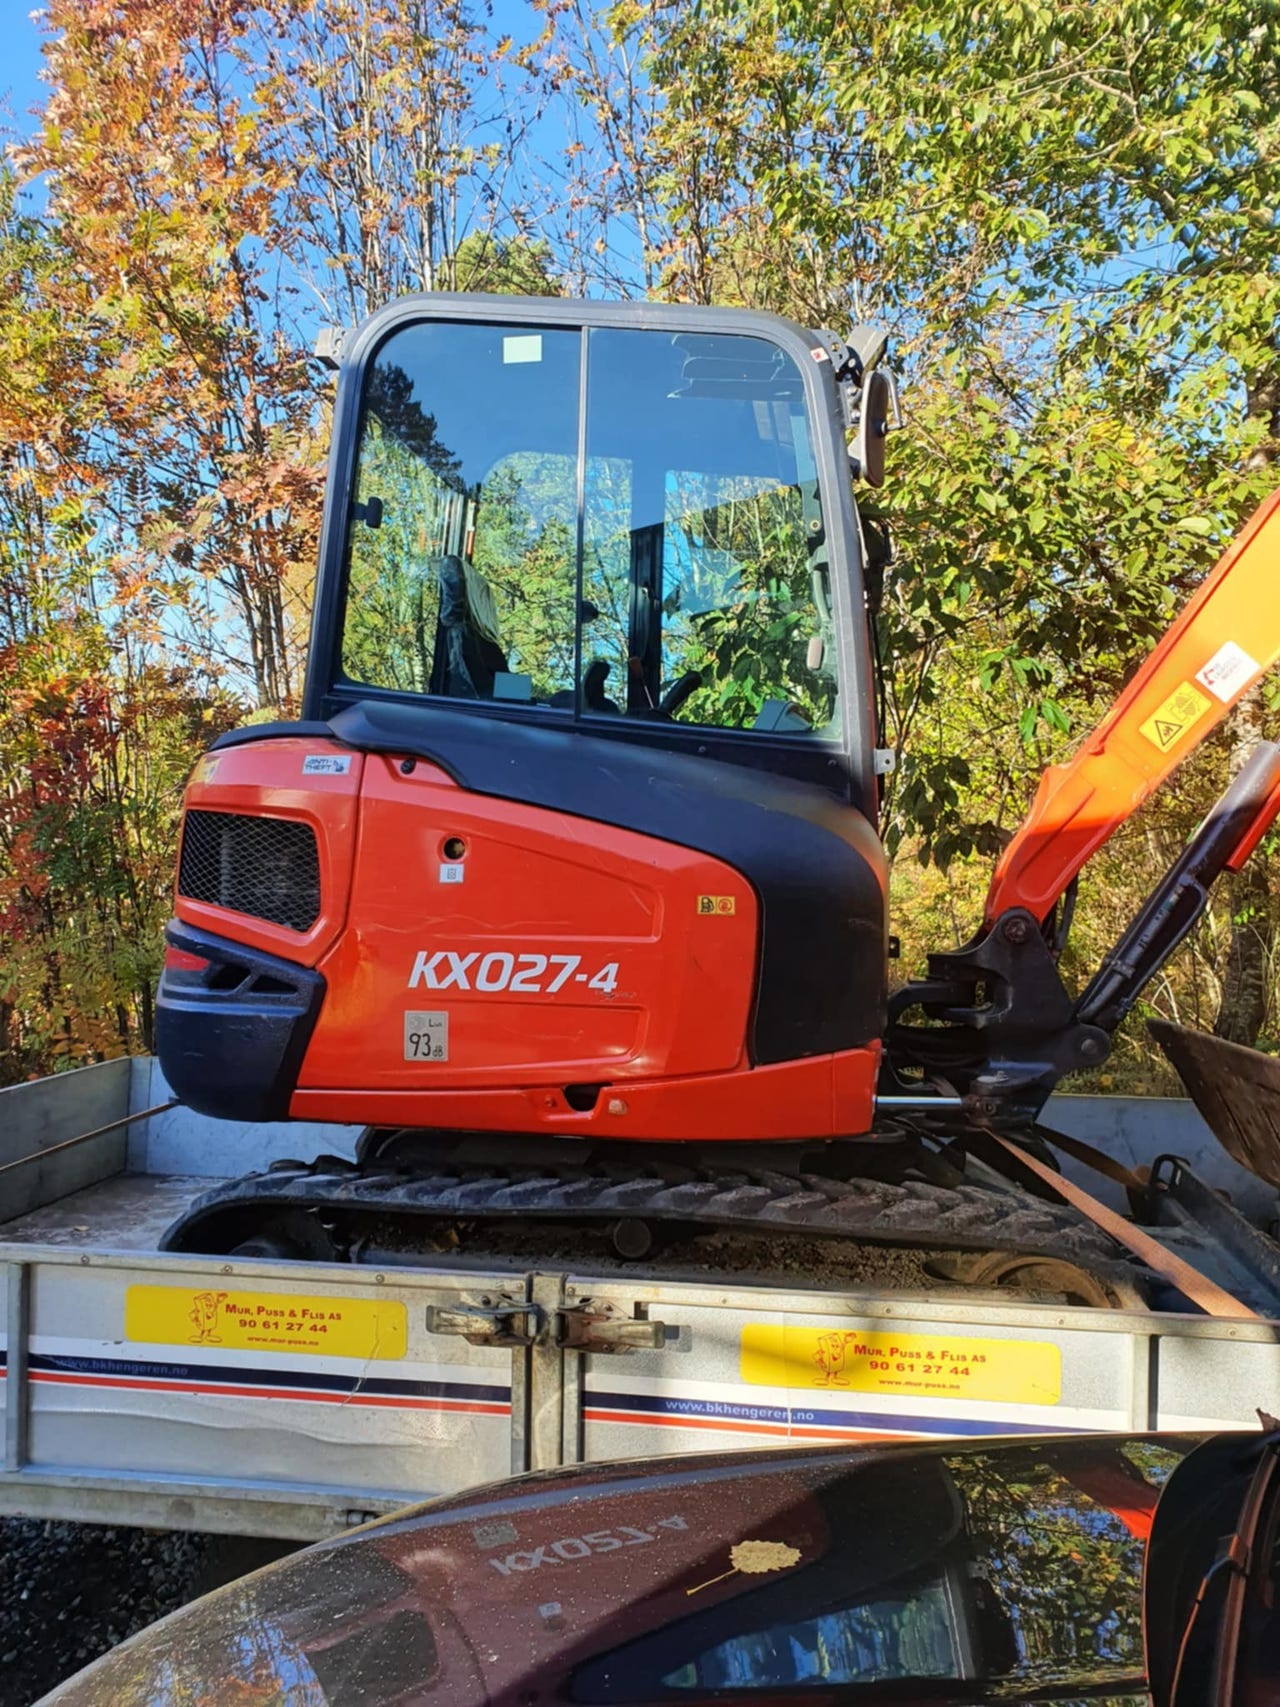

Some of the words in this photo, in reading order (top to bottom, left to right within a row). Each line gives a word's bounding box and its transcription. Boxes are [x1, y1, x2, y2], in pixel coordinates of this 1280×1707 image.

[407, 951, 619, 993] KX027-4
[409, 1032, 432, 1057] 93
[288, 1309, 297, 1318] &
[328, 1312, 342, 1321] AS
[239, 1319, 257, 1329] 90
[262, 1320, 279, 1330] 61
[286, 1322, 304, 1332] 27
[309, 1324, 328, 1334] 44
[926, 1351, 935, 1360] &
[971, 1354, 987, 1363] AS
[56, 1358, 189, 1376] www.bkhengeren.no
[869, 1360, 890, 1370] 90
[895, 1362, 915, 1373] 61
[922, 1364, 943, 1374] 27
[949, 1366, 970, 1376] 44
[665, 1400, 815, 1421] www.bkhengeren.no
